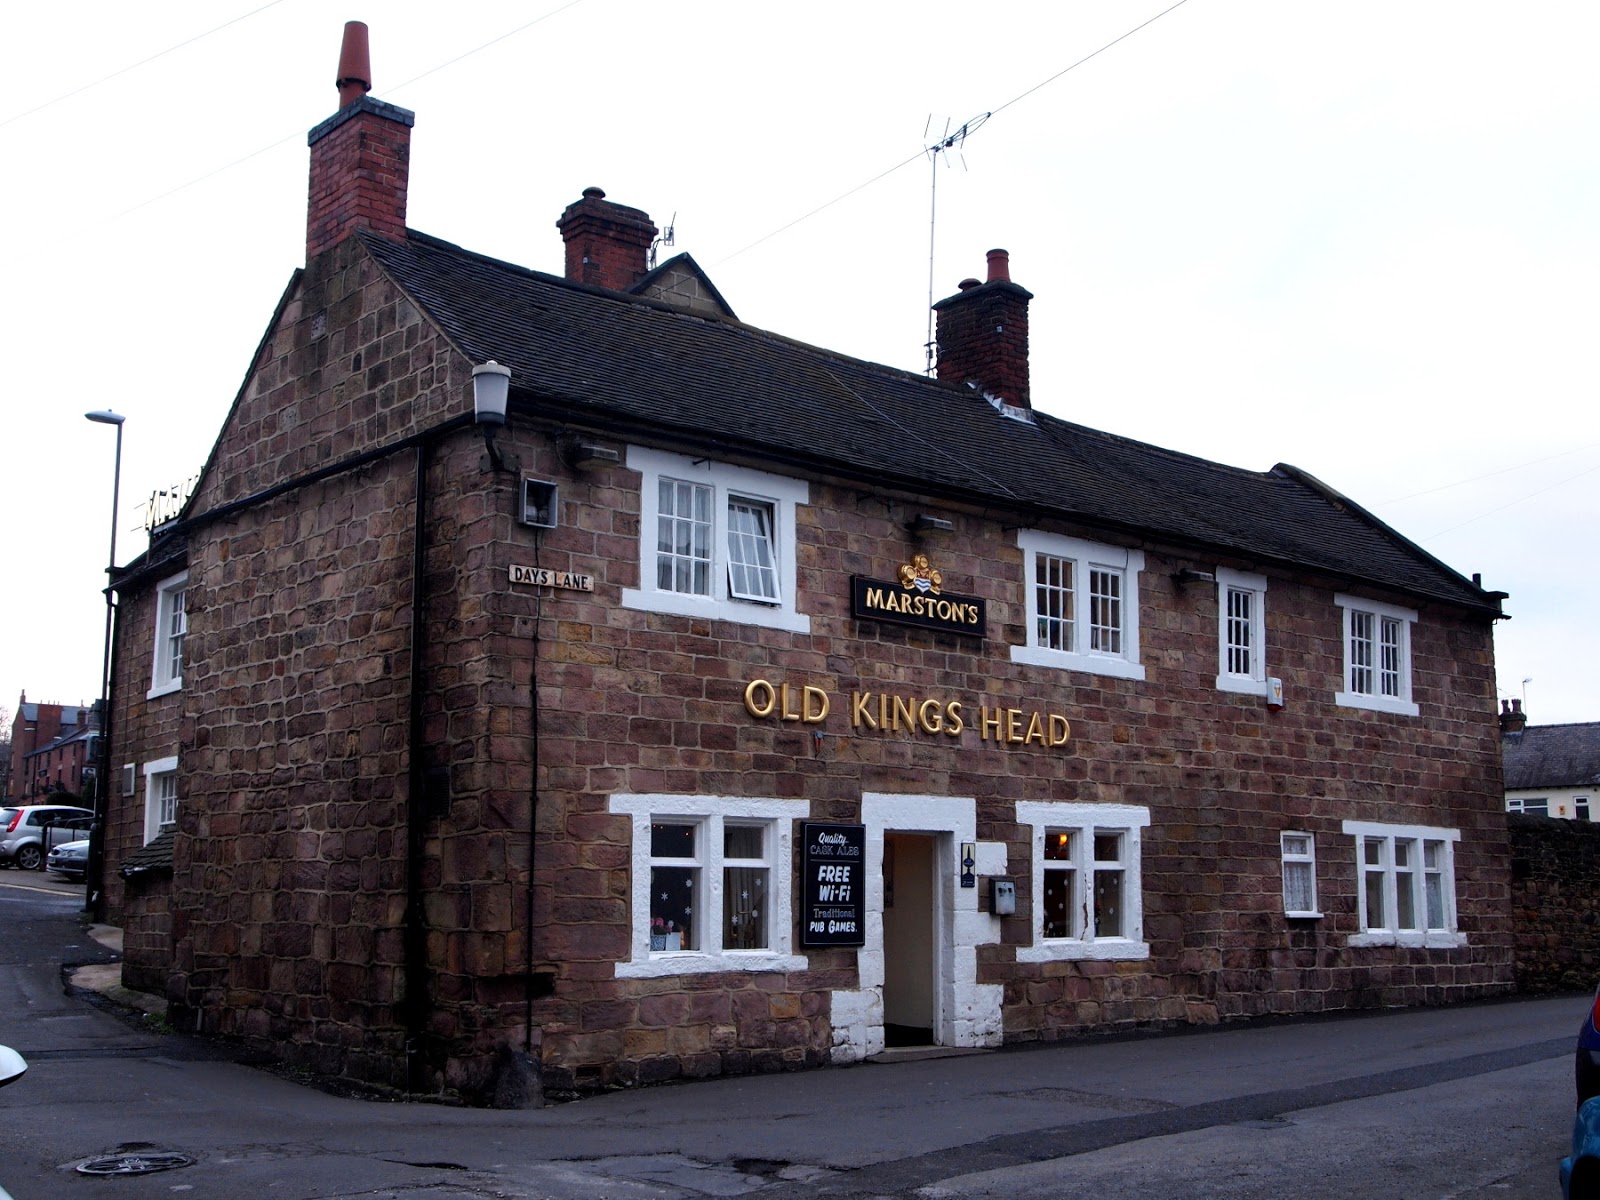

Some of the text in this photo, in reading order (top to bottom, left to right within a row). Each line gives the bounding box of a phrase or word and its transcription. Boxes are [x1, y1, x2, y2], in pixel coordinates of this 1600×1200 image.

[515, 567, 588, 590] DAYS LANE
[866, 587, 979, 625] MARSTON'S
[744, 679, 1071, 747] OLD KINGS HEAD
[810, 844, 859, 856] CASK ALES
[818, 865, 851, 883] FREE
[819, 885, 851, 902] Wi-Fi
[813, 908, 855, 918] Traditional
[809, 921, 825, 933] PUB
